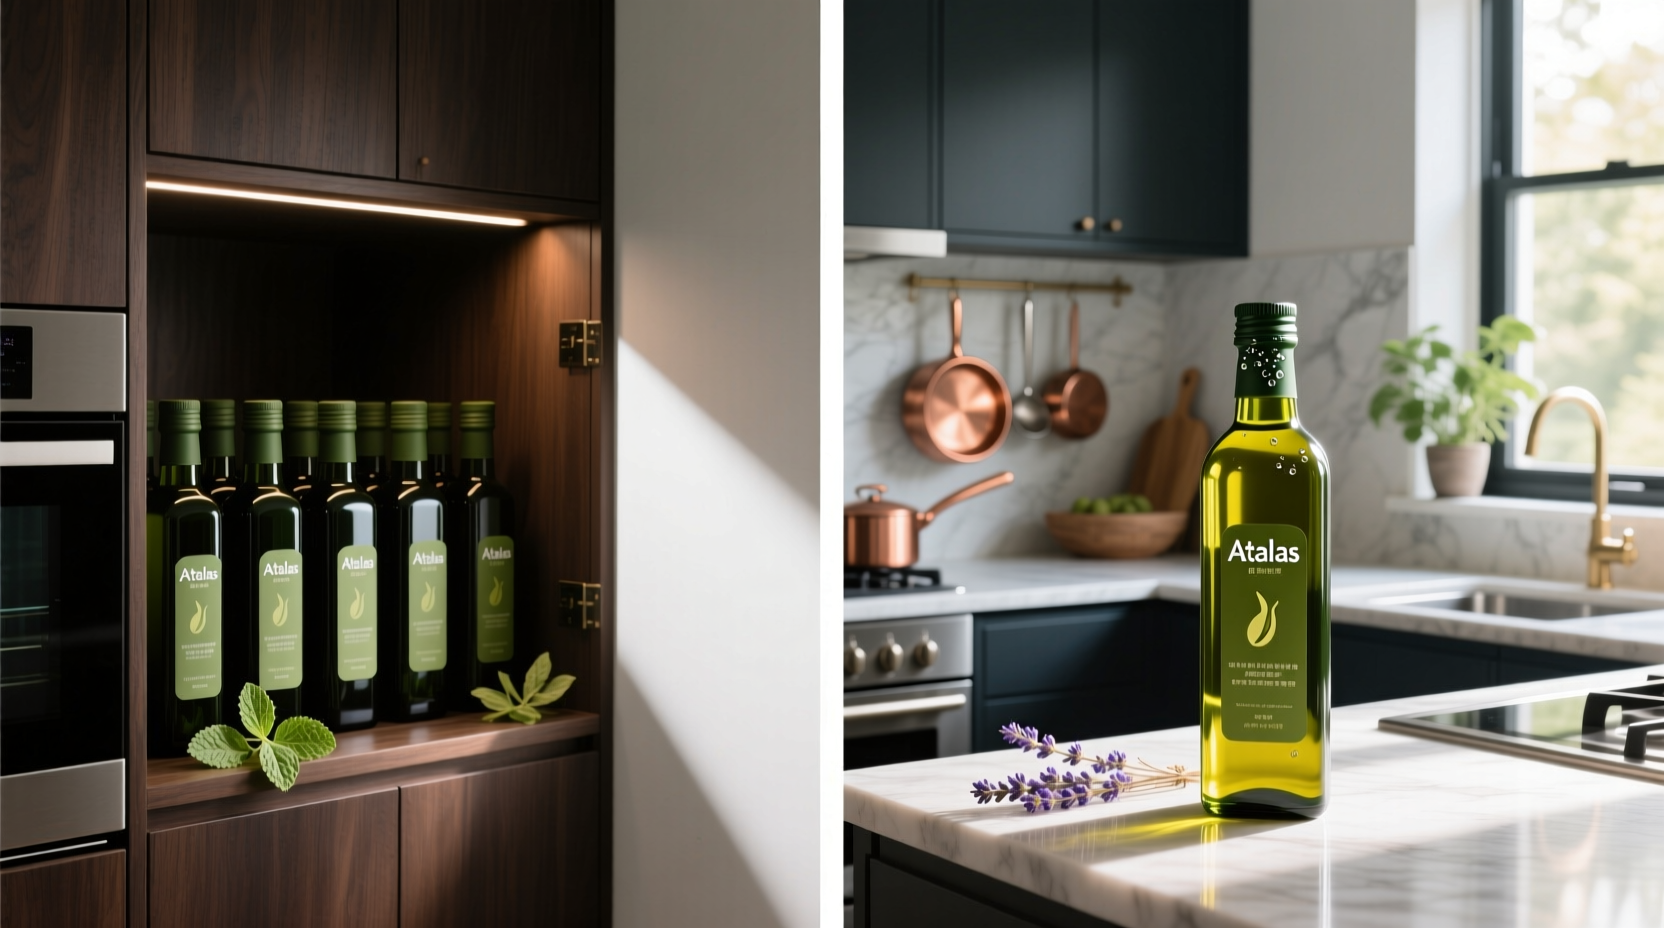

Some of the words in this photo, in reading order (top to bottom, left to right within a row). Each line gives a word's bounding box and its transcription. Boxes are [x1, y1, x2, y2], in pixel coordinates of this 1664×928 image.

[1227, 538, 1300, 563] Atalas
[179, 566, 218, 582] Atalas
[263, 561, 299, 576] Atalas
